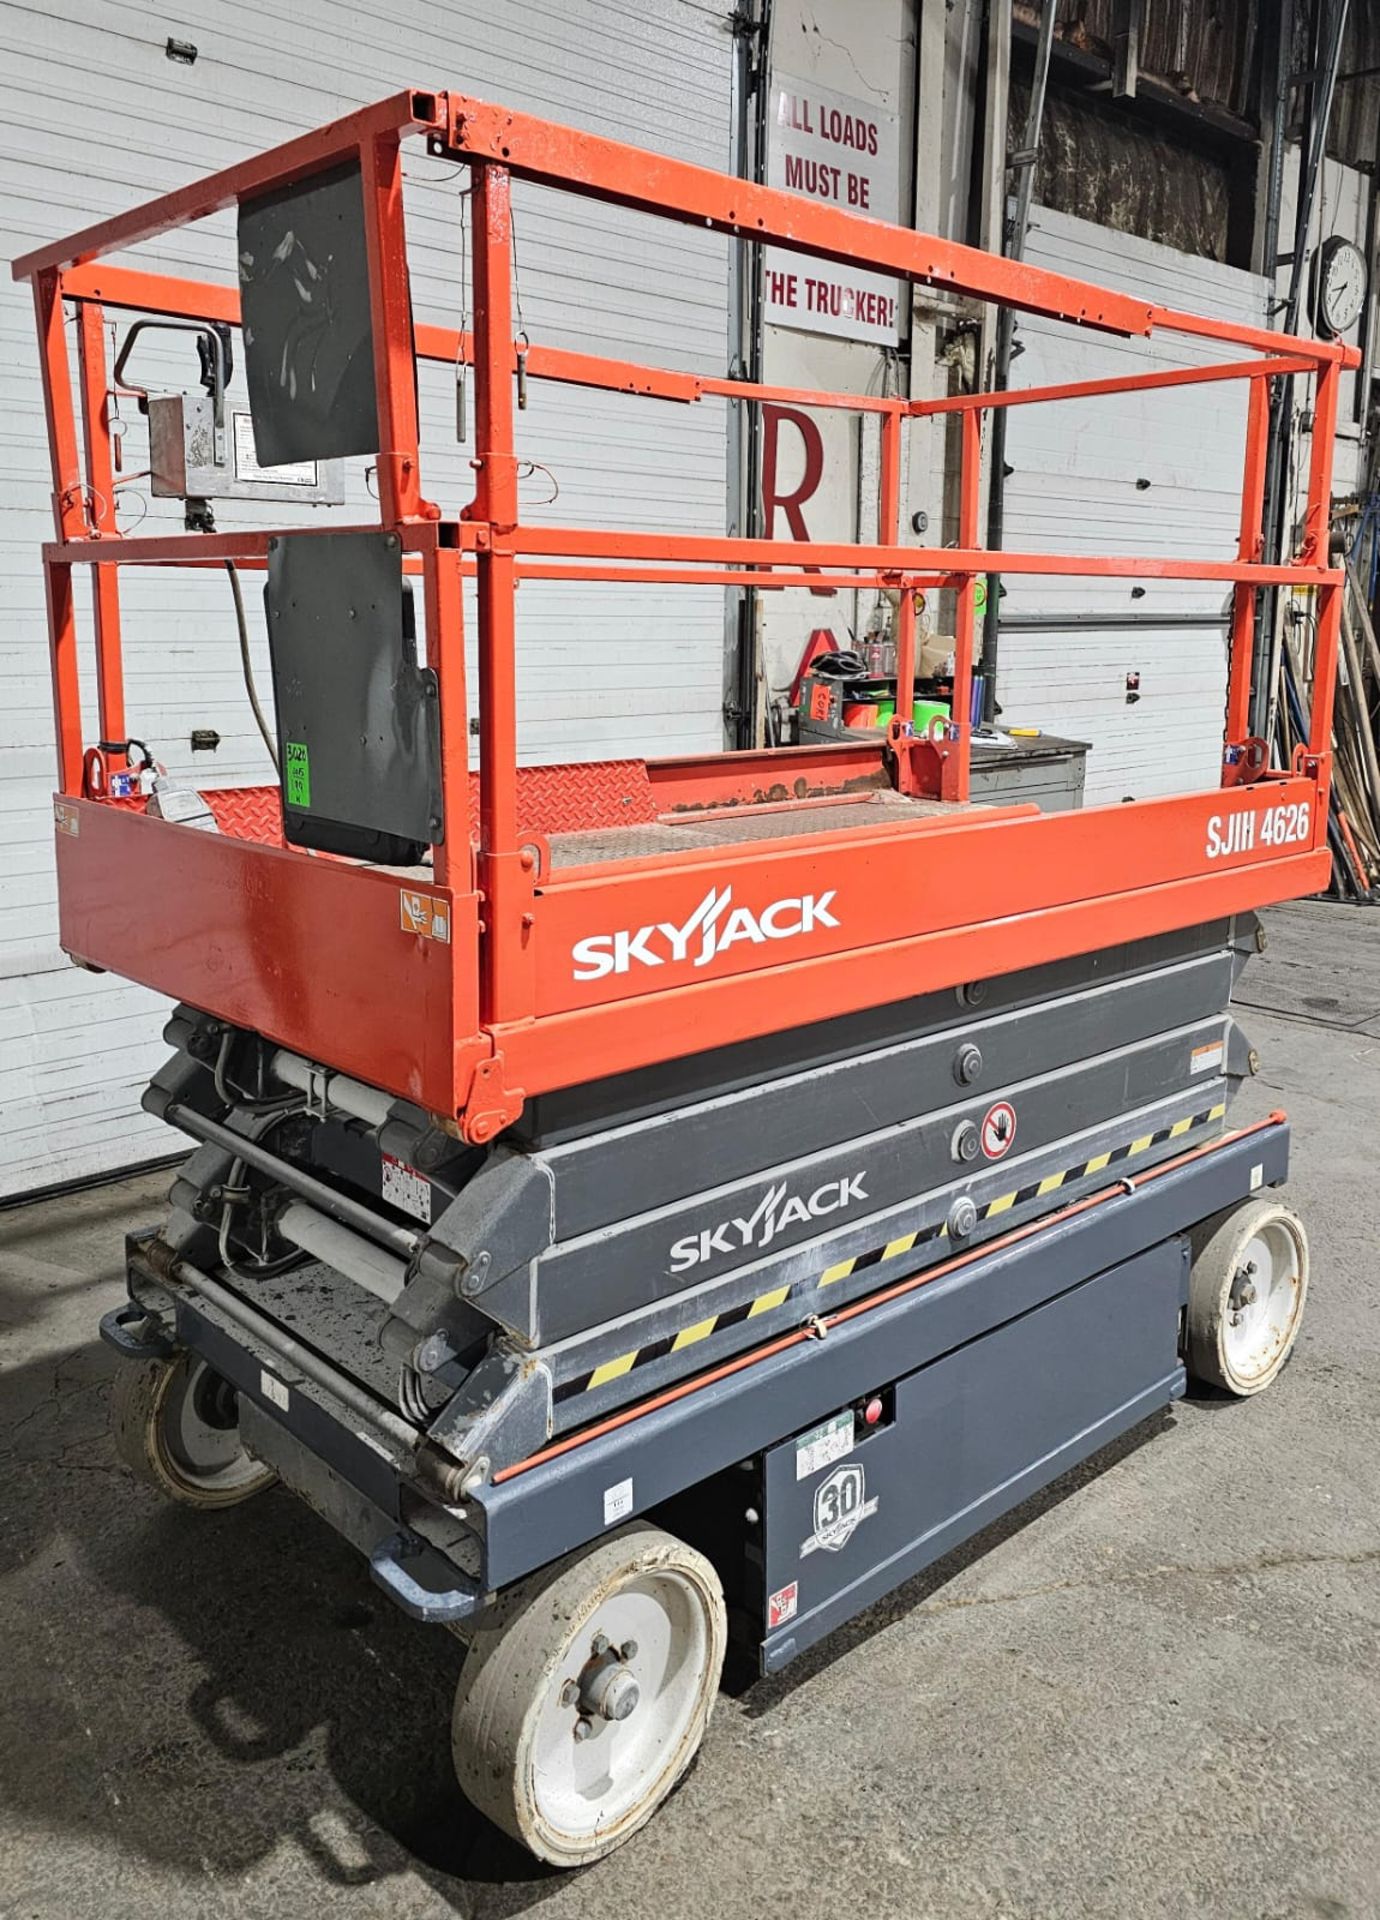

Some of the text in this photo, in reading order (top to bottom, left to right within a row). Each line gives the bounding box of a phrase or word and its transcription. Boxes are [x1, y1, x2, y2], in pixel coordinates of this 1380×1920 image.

[820, 105, 878, 156] LOADS
[785, 154, 870, 210] MUST BE
[757, 402, 838, 598] R
[1260, 802, 1309, 846] 4626
[571, 883, 841, 981] SKYJACK
[669, 1170, 870, 1273] SKYJACK
[821, 1474, 857, 1528] 30
